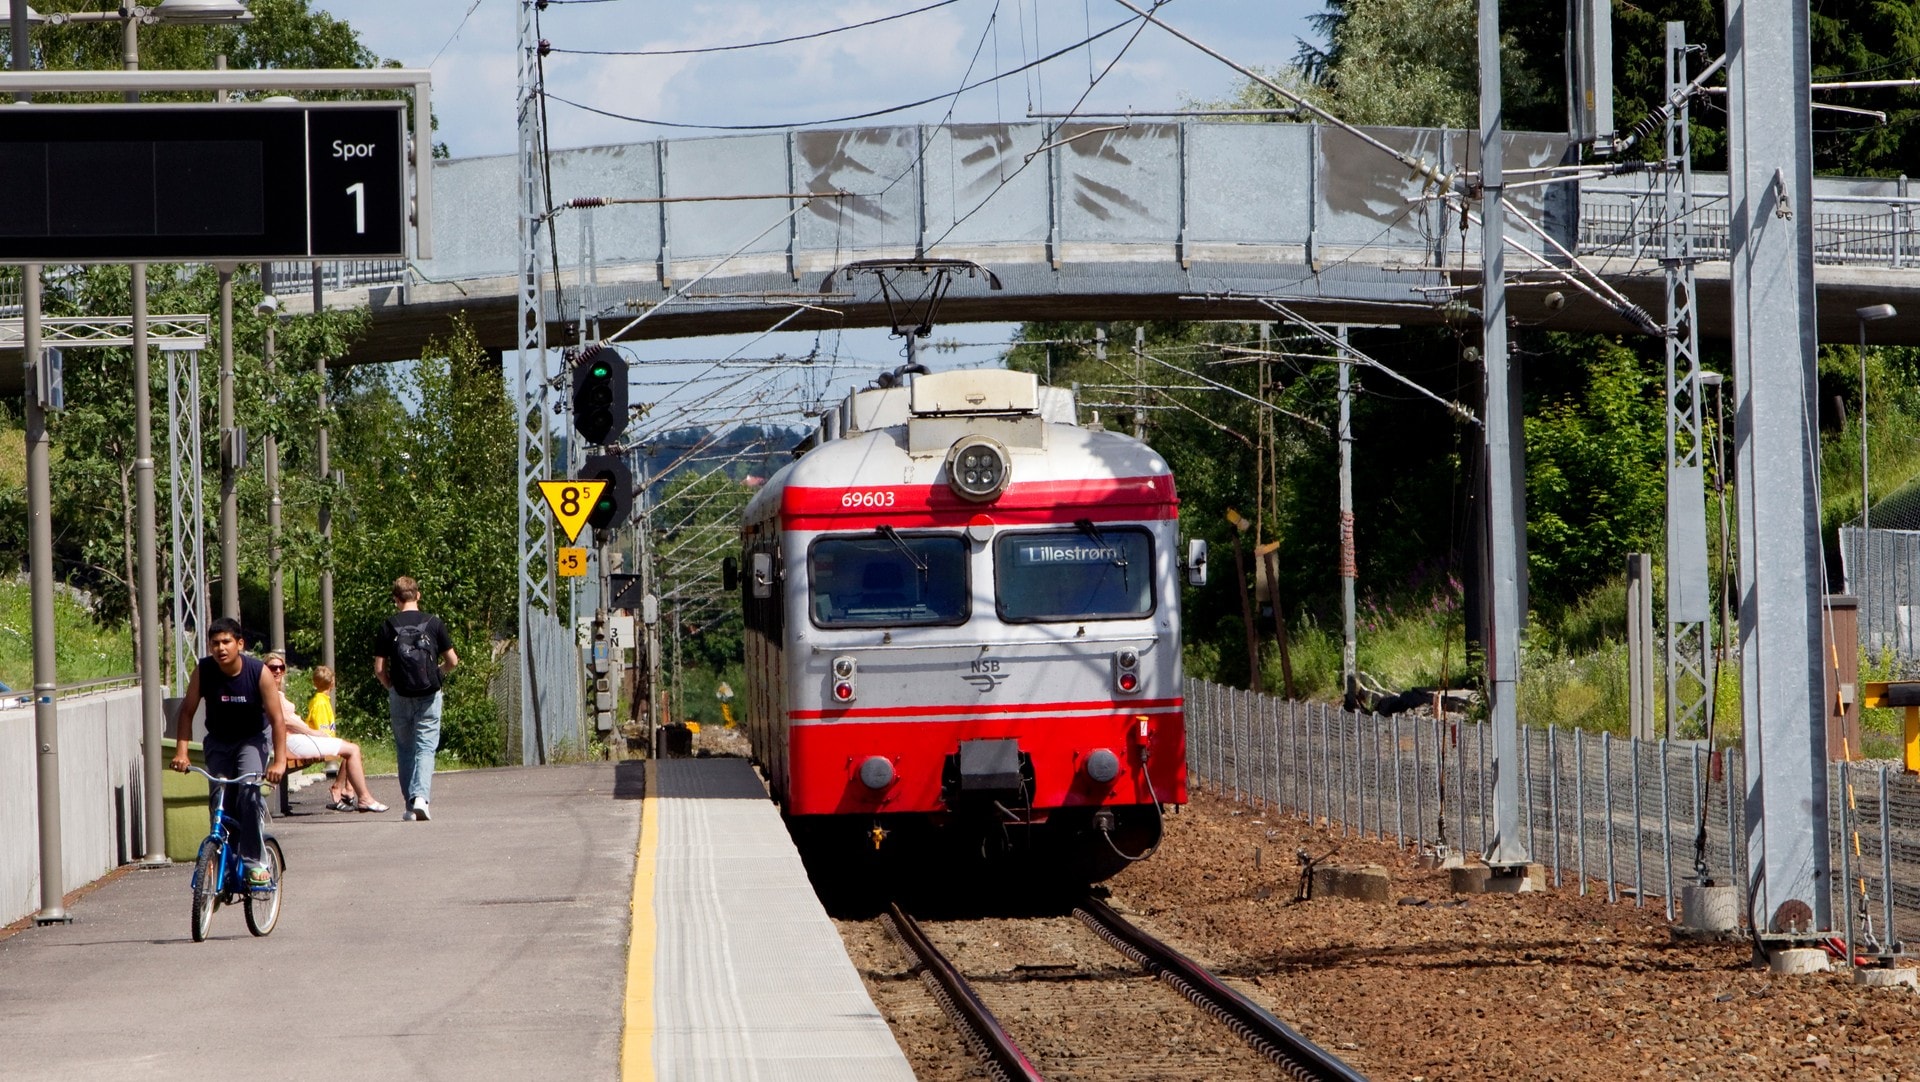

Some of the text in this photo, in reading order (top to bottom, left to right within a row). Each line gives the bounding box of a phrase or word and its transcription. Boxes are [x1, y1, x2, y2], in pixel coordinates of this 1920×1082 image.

[332, 139, 376, 162] Spor
[345, 182, 365, 234] 1
[841, 491, 895, 507] 69603
[1029, 546, 1117, 562] Lillestrøm
[970, 660, 1000, 673] NSB
